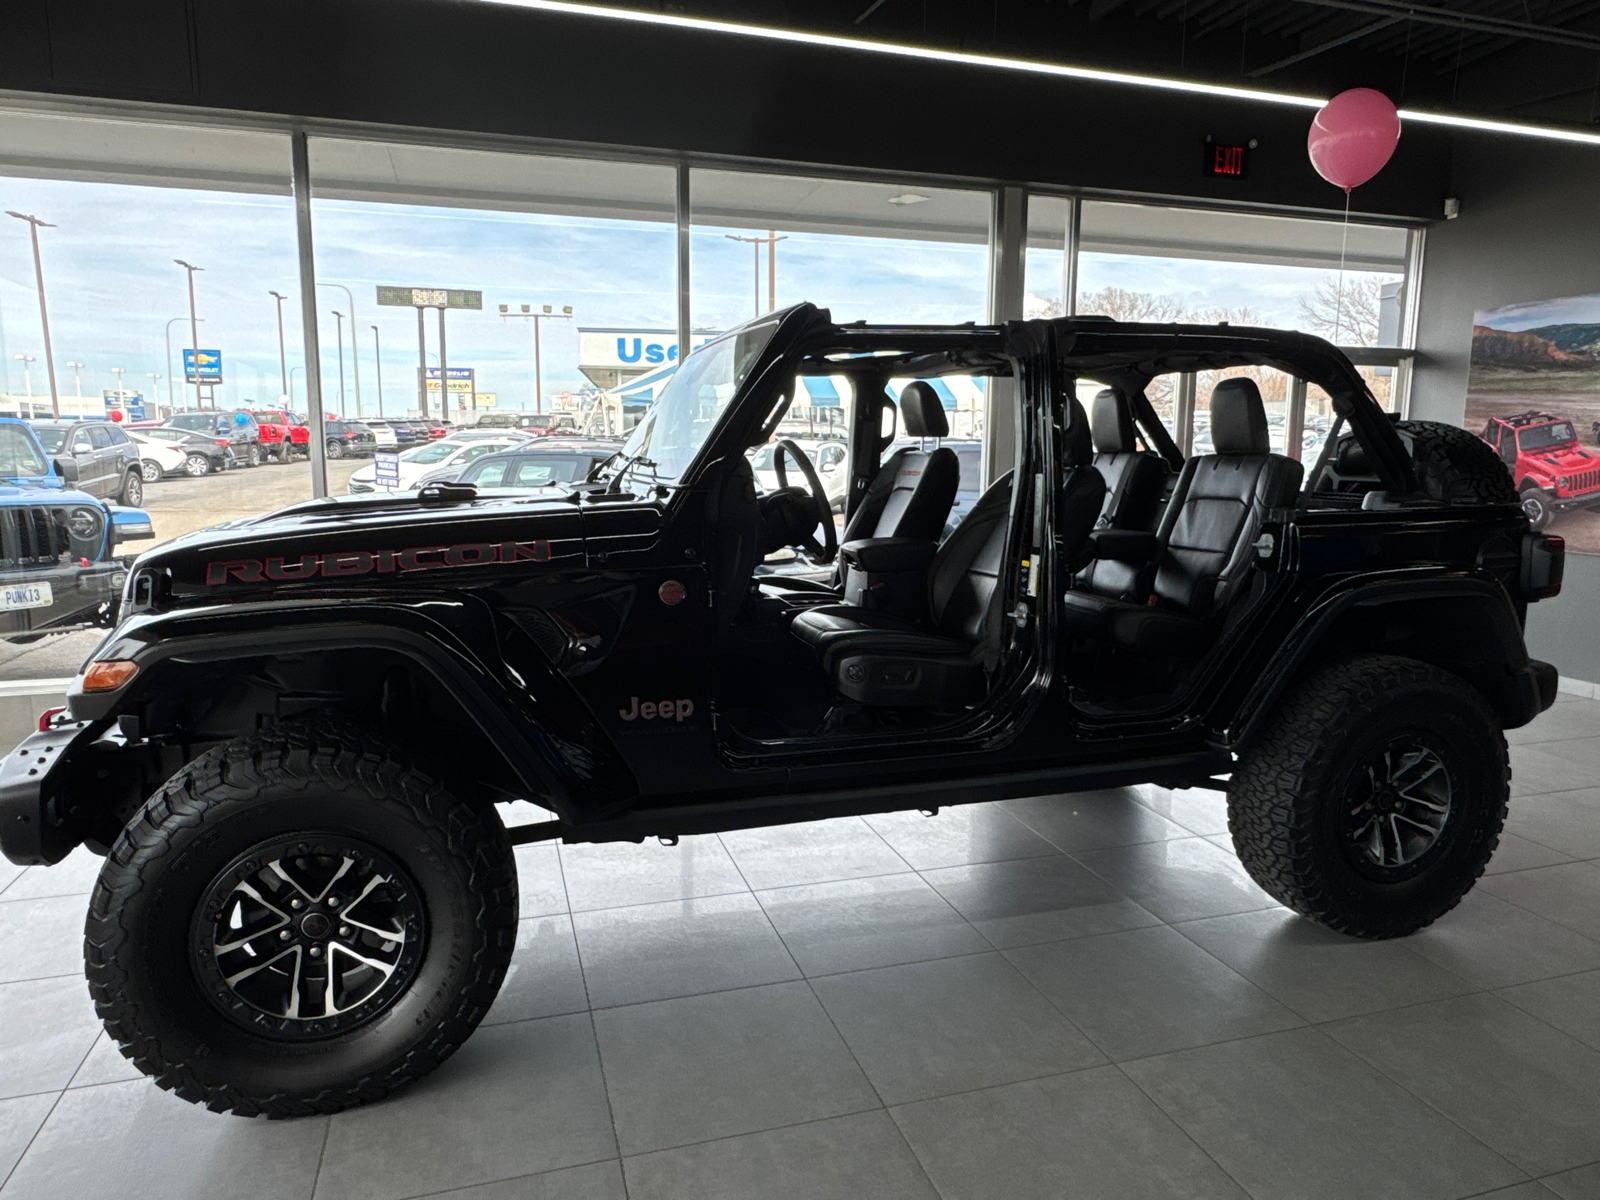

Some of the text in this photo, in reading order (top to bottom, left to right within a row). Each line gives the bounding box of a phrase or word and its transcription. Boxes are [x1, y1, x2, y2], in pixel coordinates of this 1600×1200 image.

[1214, 146, 1244, 175] EXIT
[617, 337, 713, 364] Use
[206, 539, 552, 586] RUBICON
[618, 695, 695, 722] Jeep
